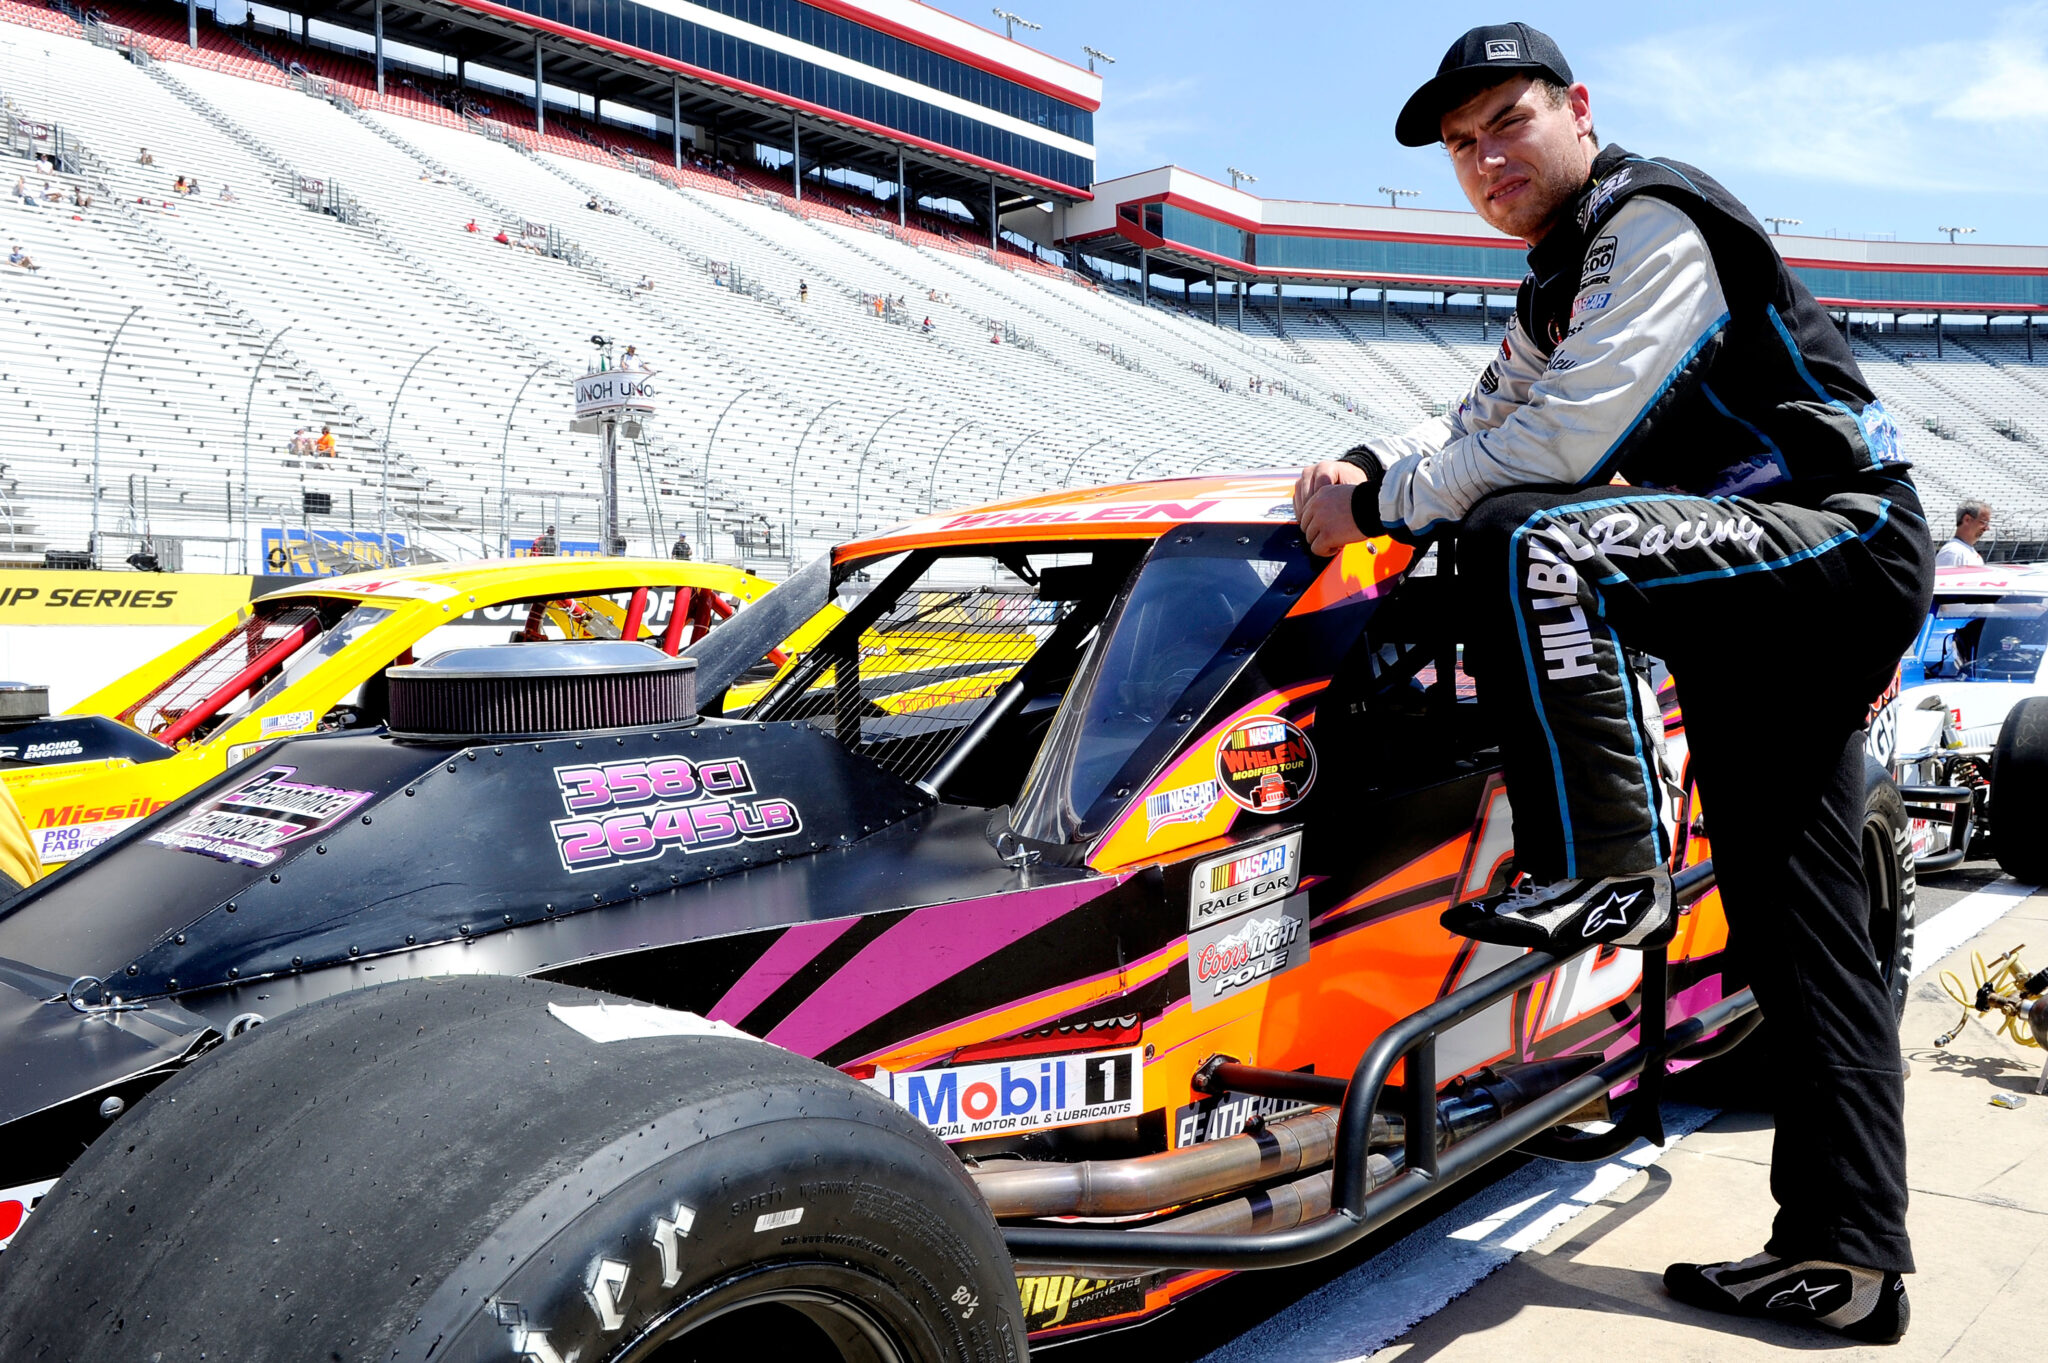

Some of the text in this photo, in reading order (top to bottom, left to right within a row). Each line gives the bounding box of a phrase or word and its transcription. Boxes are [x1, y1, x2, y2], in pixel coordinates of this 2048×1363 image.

[575, 381, 655, 403] UNOH UNO
[939, 500, 1222, 530] WHELEN
[1588, 512, 1765, 558] Racing
[45, 589, 178, 608] SERIES
[27, 740, 80, 753] RACING
[1249, 723, 1286, 747] NASCAR
[23, 747, 83, 759] ENGINES
[1220, 736, 1307, 773] WHELEN
[555, 756, 700, 815] 358
[1232, 760, 1304, 781] MODIFIED TOUR
[1171, 781, 1215, 812] NASCAR
[37, 797, 174, 829] Missile
[44, 828, 81, 843] PRO
[1234, 846, 1283, 883] NASCAR
[1198, 876, 1292, 917] RACE CAR
[1197, 918, 1304, 983] Coors LIGHT
[1213, 950, 1290, 998] POLE
[907, 1061, 1067, 1125] Mobil
[971, 1117, 1016, 1134] MOTOR
[1020, 1115, 1040, 1127] OIL
[1044, 1113, 1052, 1123] &
[1056, 1102, 1132, 1122] LUBRICANTS
[731, 1187, 787, 1217] SAFETY
[1071, 1277, 1141, 1309] SYNTHETICS
